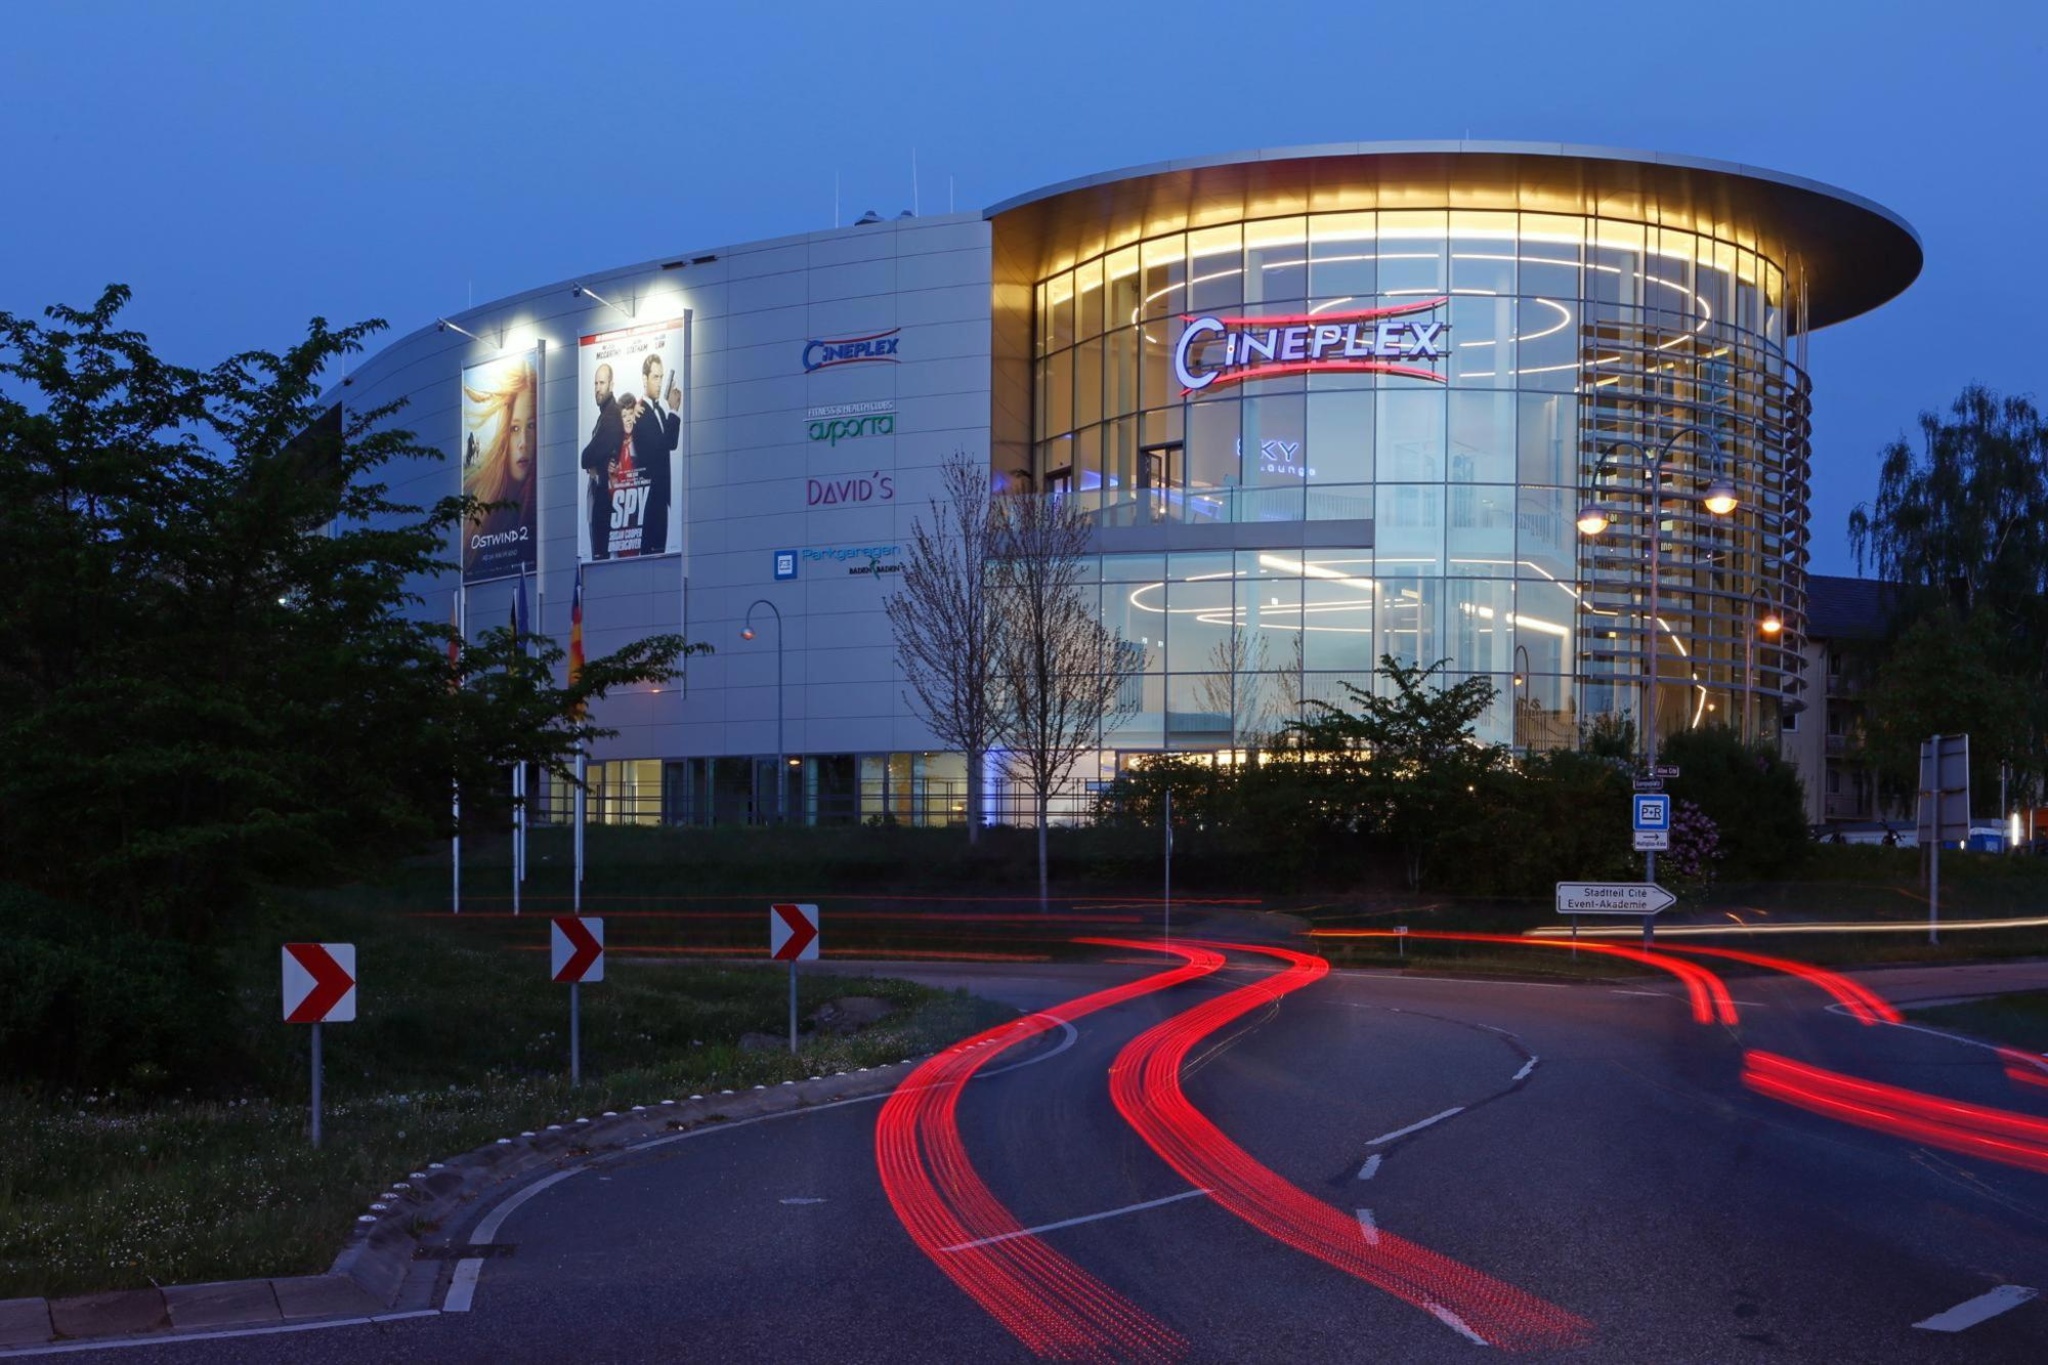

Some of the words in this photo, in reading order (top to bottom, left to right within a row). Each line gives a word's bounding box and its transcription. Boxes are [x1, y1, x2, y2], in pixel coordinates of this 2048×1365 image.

[802, 338, 900, 371] CINEPLEX
[1175, 315, 1443, 390] CINEPLEX
[1236, 438, 1299, 463] KY
[610, 485, 651, 529] SPY
[471, 530, 518, 549] OSTWIND
[519, 526, 529, 541] 2
[1567, 900, 1647, 909] Event-Akademie
[1584, 888, 1624, 898] Stadtteil
